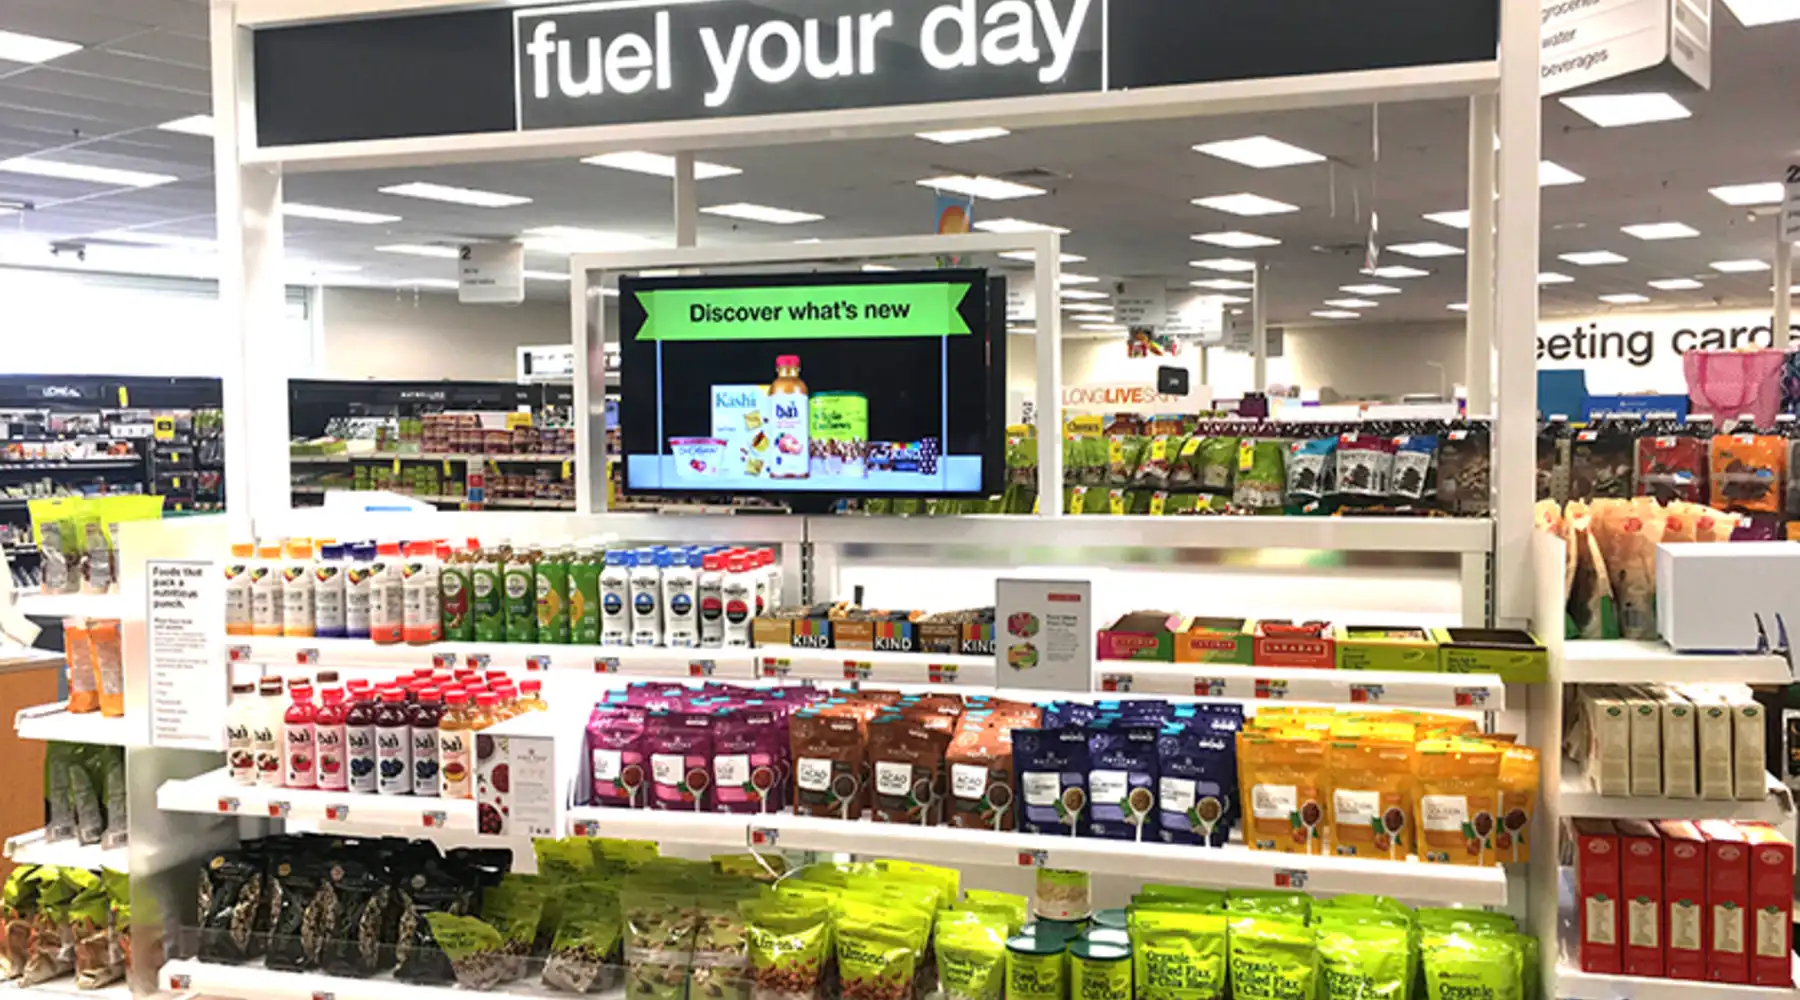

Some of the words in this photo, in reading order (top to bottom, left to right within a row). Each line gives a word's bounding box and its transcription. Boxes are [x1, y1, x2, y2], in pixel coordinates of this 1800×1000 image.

[1541, 28, 1577, 48] water
[527, 11, 672, 98] fuel
[699, 9, 894, 107] your
[920, 0, 1093, 83] day
[1541, 48, 1609, 78] beverages
[461, 245, 472, 260] 2
[689, 303, 782, 322] Discover
[789, 300, 858, 321] what's
[864, 302, 911, 320] new
[715, 391, 757, 409] Kashi
[793, 634, 830, 648] KIND
[875, 637, 913, 651] KIND
